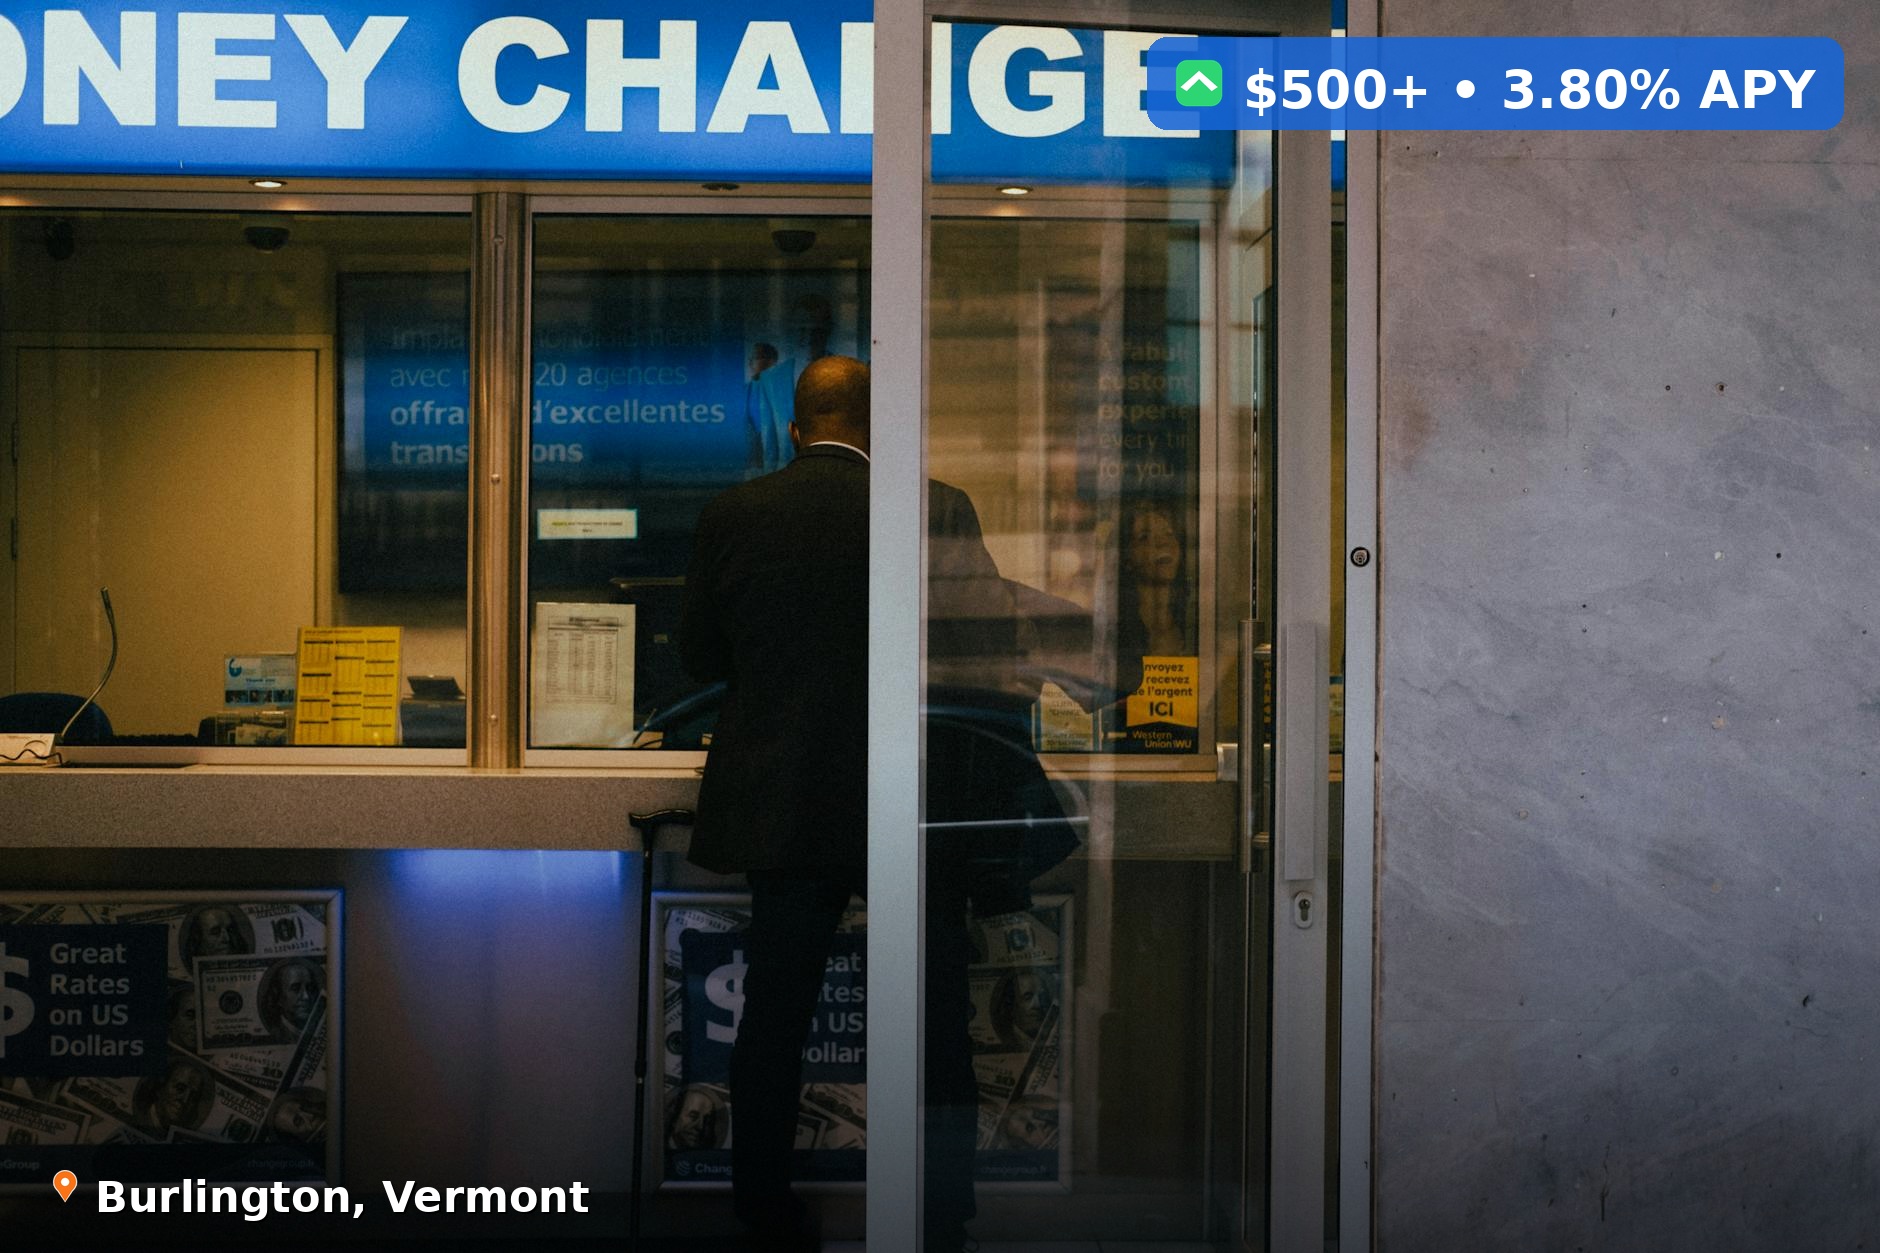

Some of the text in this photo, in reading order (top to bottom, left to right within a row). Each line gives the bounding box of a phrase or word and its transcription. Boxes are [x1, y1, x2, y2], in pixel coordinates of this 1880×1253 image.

[0, 10, 410, 130] NEY
[390, 367, 451, 388] avec
[577, 366, 688, 392] agences
[390, 400, 469, 427] offra
[1136, 462, 1175, 485] you
[1144, 663, 1184, 674] nvoyez
[1146, 676, 1189, 685] recevez
[1147, 686, 1193, 698] l'argent
[1149, 701, 1173, 717] ICI
[1133, 731, 1172, 740] Western
[1145, 740, 1173, 749] Union
[49, 943, 127, 966] Great
[824, 951, 862, 973] eat
[50, 974, 130, 996] Rates
[49, 1004, 129, 1026] on US
[828, 1012, 865, 1033] US
[50, 1035, 144, 1057] Dollars
[801, 1041, 866, 1063] ollar
